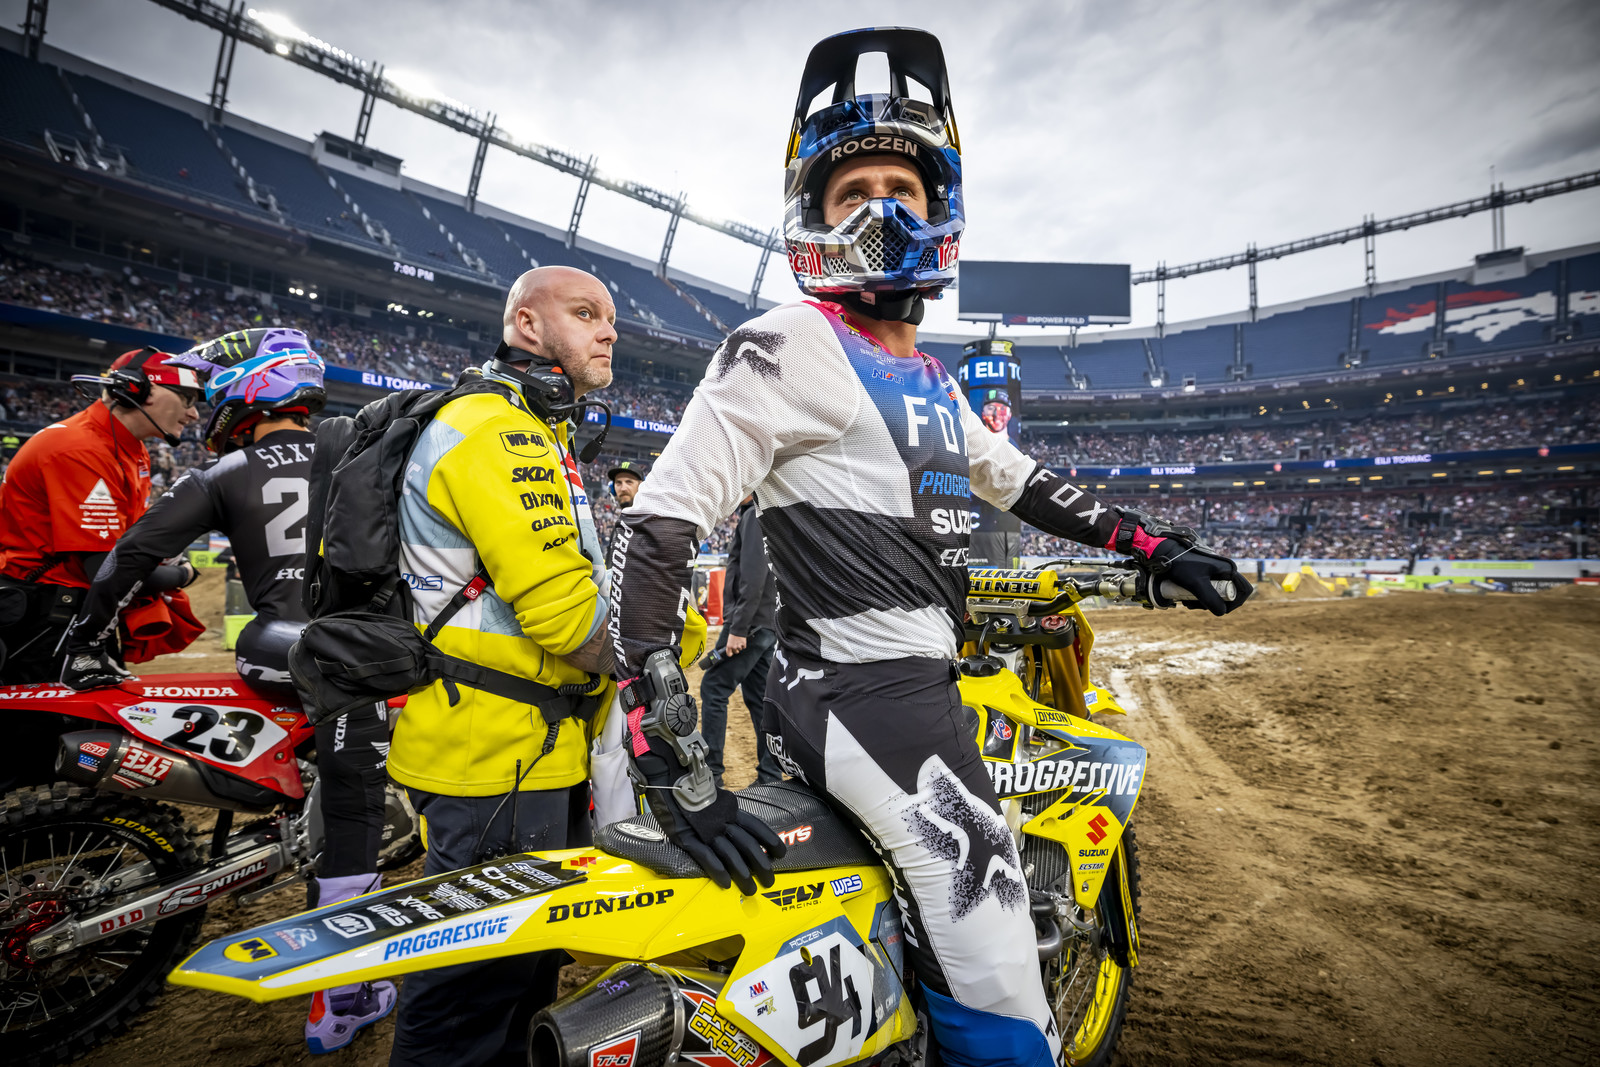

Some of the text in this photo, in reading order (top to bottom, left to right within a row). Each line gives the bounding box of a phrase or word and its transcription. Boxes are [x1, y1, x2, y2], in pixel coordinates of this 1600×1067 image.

[831, 136, 918, 162] ROCZEN
[393, 261, 434, 282] 7:00 PM
[1026, 316, 1085, 325] EMPOWER FIELD
[362, 372, 383, 387] ELI
[975, 361, 1004, 379] ELI
[587, 411, 599, 422] #1
[634, 419, 648, 430] ELI
[902, 394, 968, 457] FO
[505, 433, 547, 449] WD-40
[1151, 466, 1167, 475] ELI
[1168, 465, 1196, 475] TOMAC
[1374, 456, 1391, 466] ELI
[1392, 453, 1432, 465] TOMAC
[1028, 468, 1108, 526] FOX
[142, 687, 239, 698] HONDA
[129, 705, 157, 714] AMA
[1037, 711, 1069, 723] DIXXON
[161, 705, 265, 763] 23
[333, 713, 349, 753] NDA
[109, 817, 175, 853] DUNLOP
[1078, 849, 1109, 857] SUZUKI
[1078, 863, 1105, 871] ECSTAR
[774, 882, 826, 906] FLY
[830, 874, 863, 897] WPS
[366, 903, 414, 927] WPS
[396, 895, 446, 920] XTRIG
[546, 888, 675, 924] DUNLOP
[100, 909, 144, 934] D.I.D
[384, 916, 510, 961] PROGRESSIVE
[788, 928, 825, 950] ROCZEN
[749, 980, 769, 999] AMA
[788, 943, 863, 1067] 94
[698, 1001, 739, 1036] PRO
[690, 1015, 756, 1066] CIRCUIT
[597, 1054, 632, 1067] Ti-6
